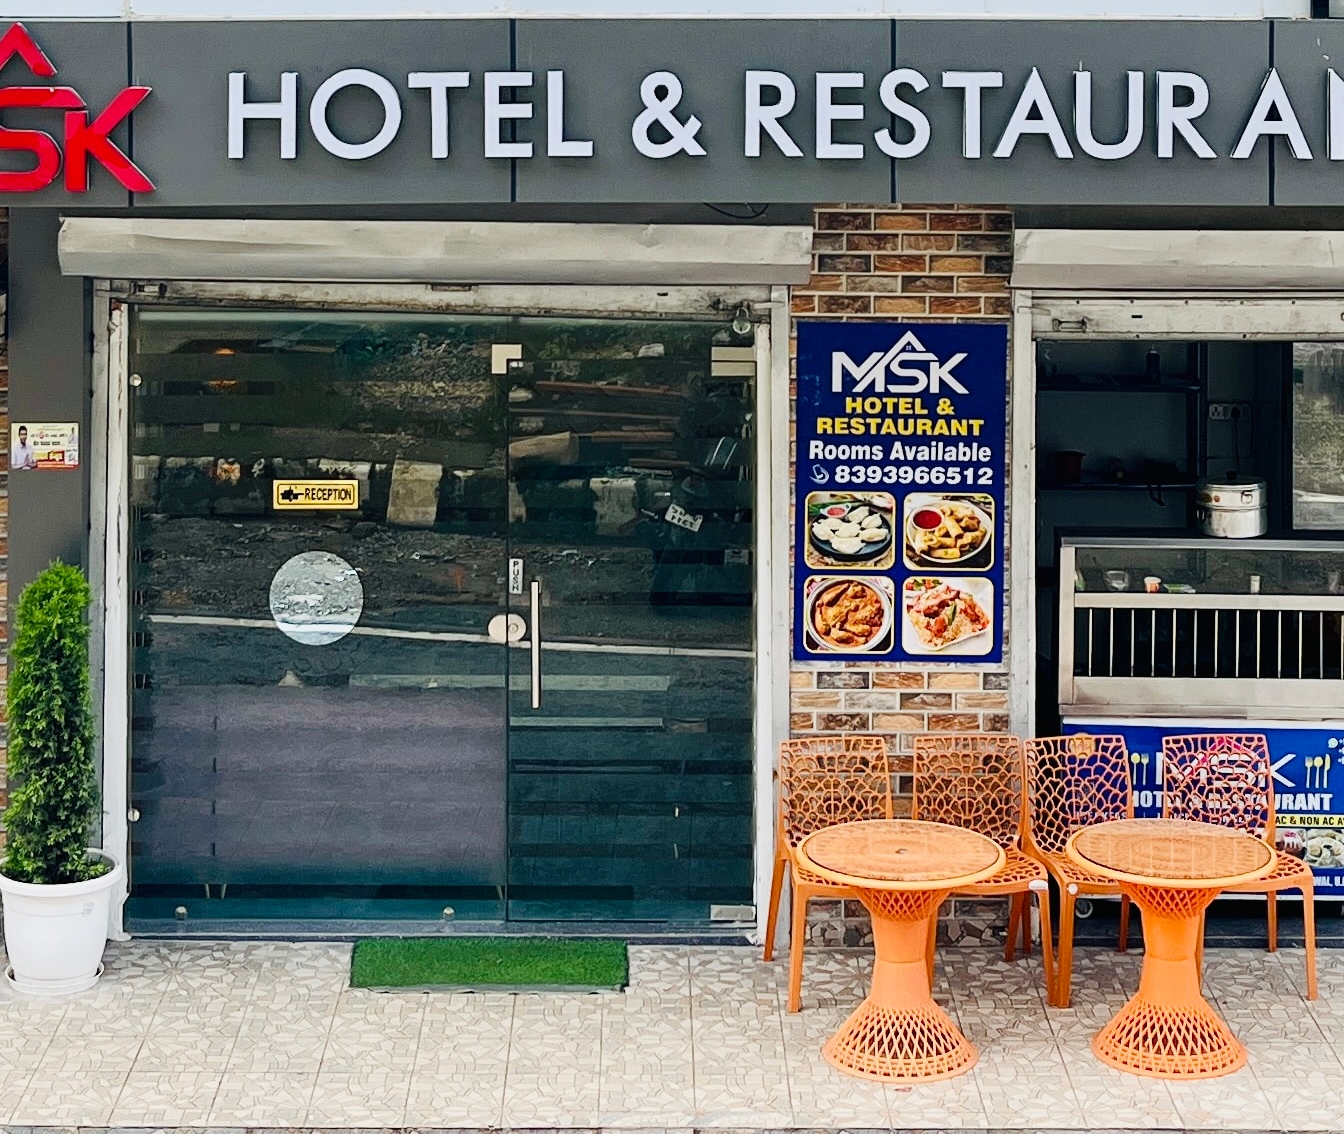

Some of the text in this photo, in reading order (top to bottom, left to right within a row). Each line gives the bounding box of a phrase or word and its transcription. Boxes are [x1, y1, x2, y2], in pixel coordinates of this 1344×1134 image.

[227, 68, 594, 160] HOTEL
[631, 70, 707, 159] &
[832, 330, 970, 394] MSK
[845, 397, 955, 415] HOTEL &
[816, 417, 985, 437] RESTAURANT
[809, 440, 992, 462] Rooms Available
[834, 465, 993, 485] 8393966512
[304, 487, 352, 501] RECEPTION
[512, 560, 520, 592] PUSH
[1290, 816, 1297, 825] &
[1300, 816, 1320, 825] NON
[1323, 817, 1335, 825] AC
